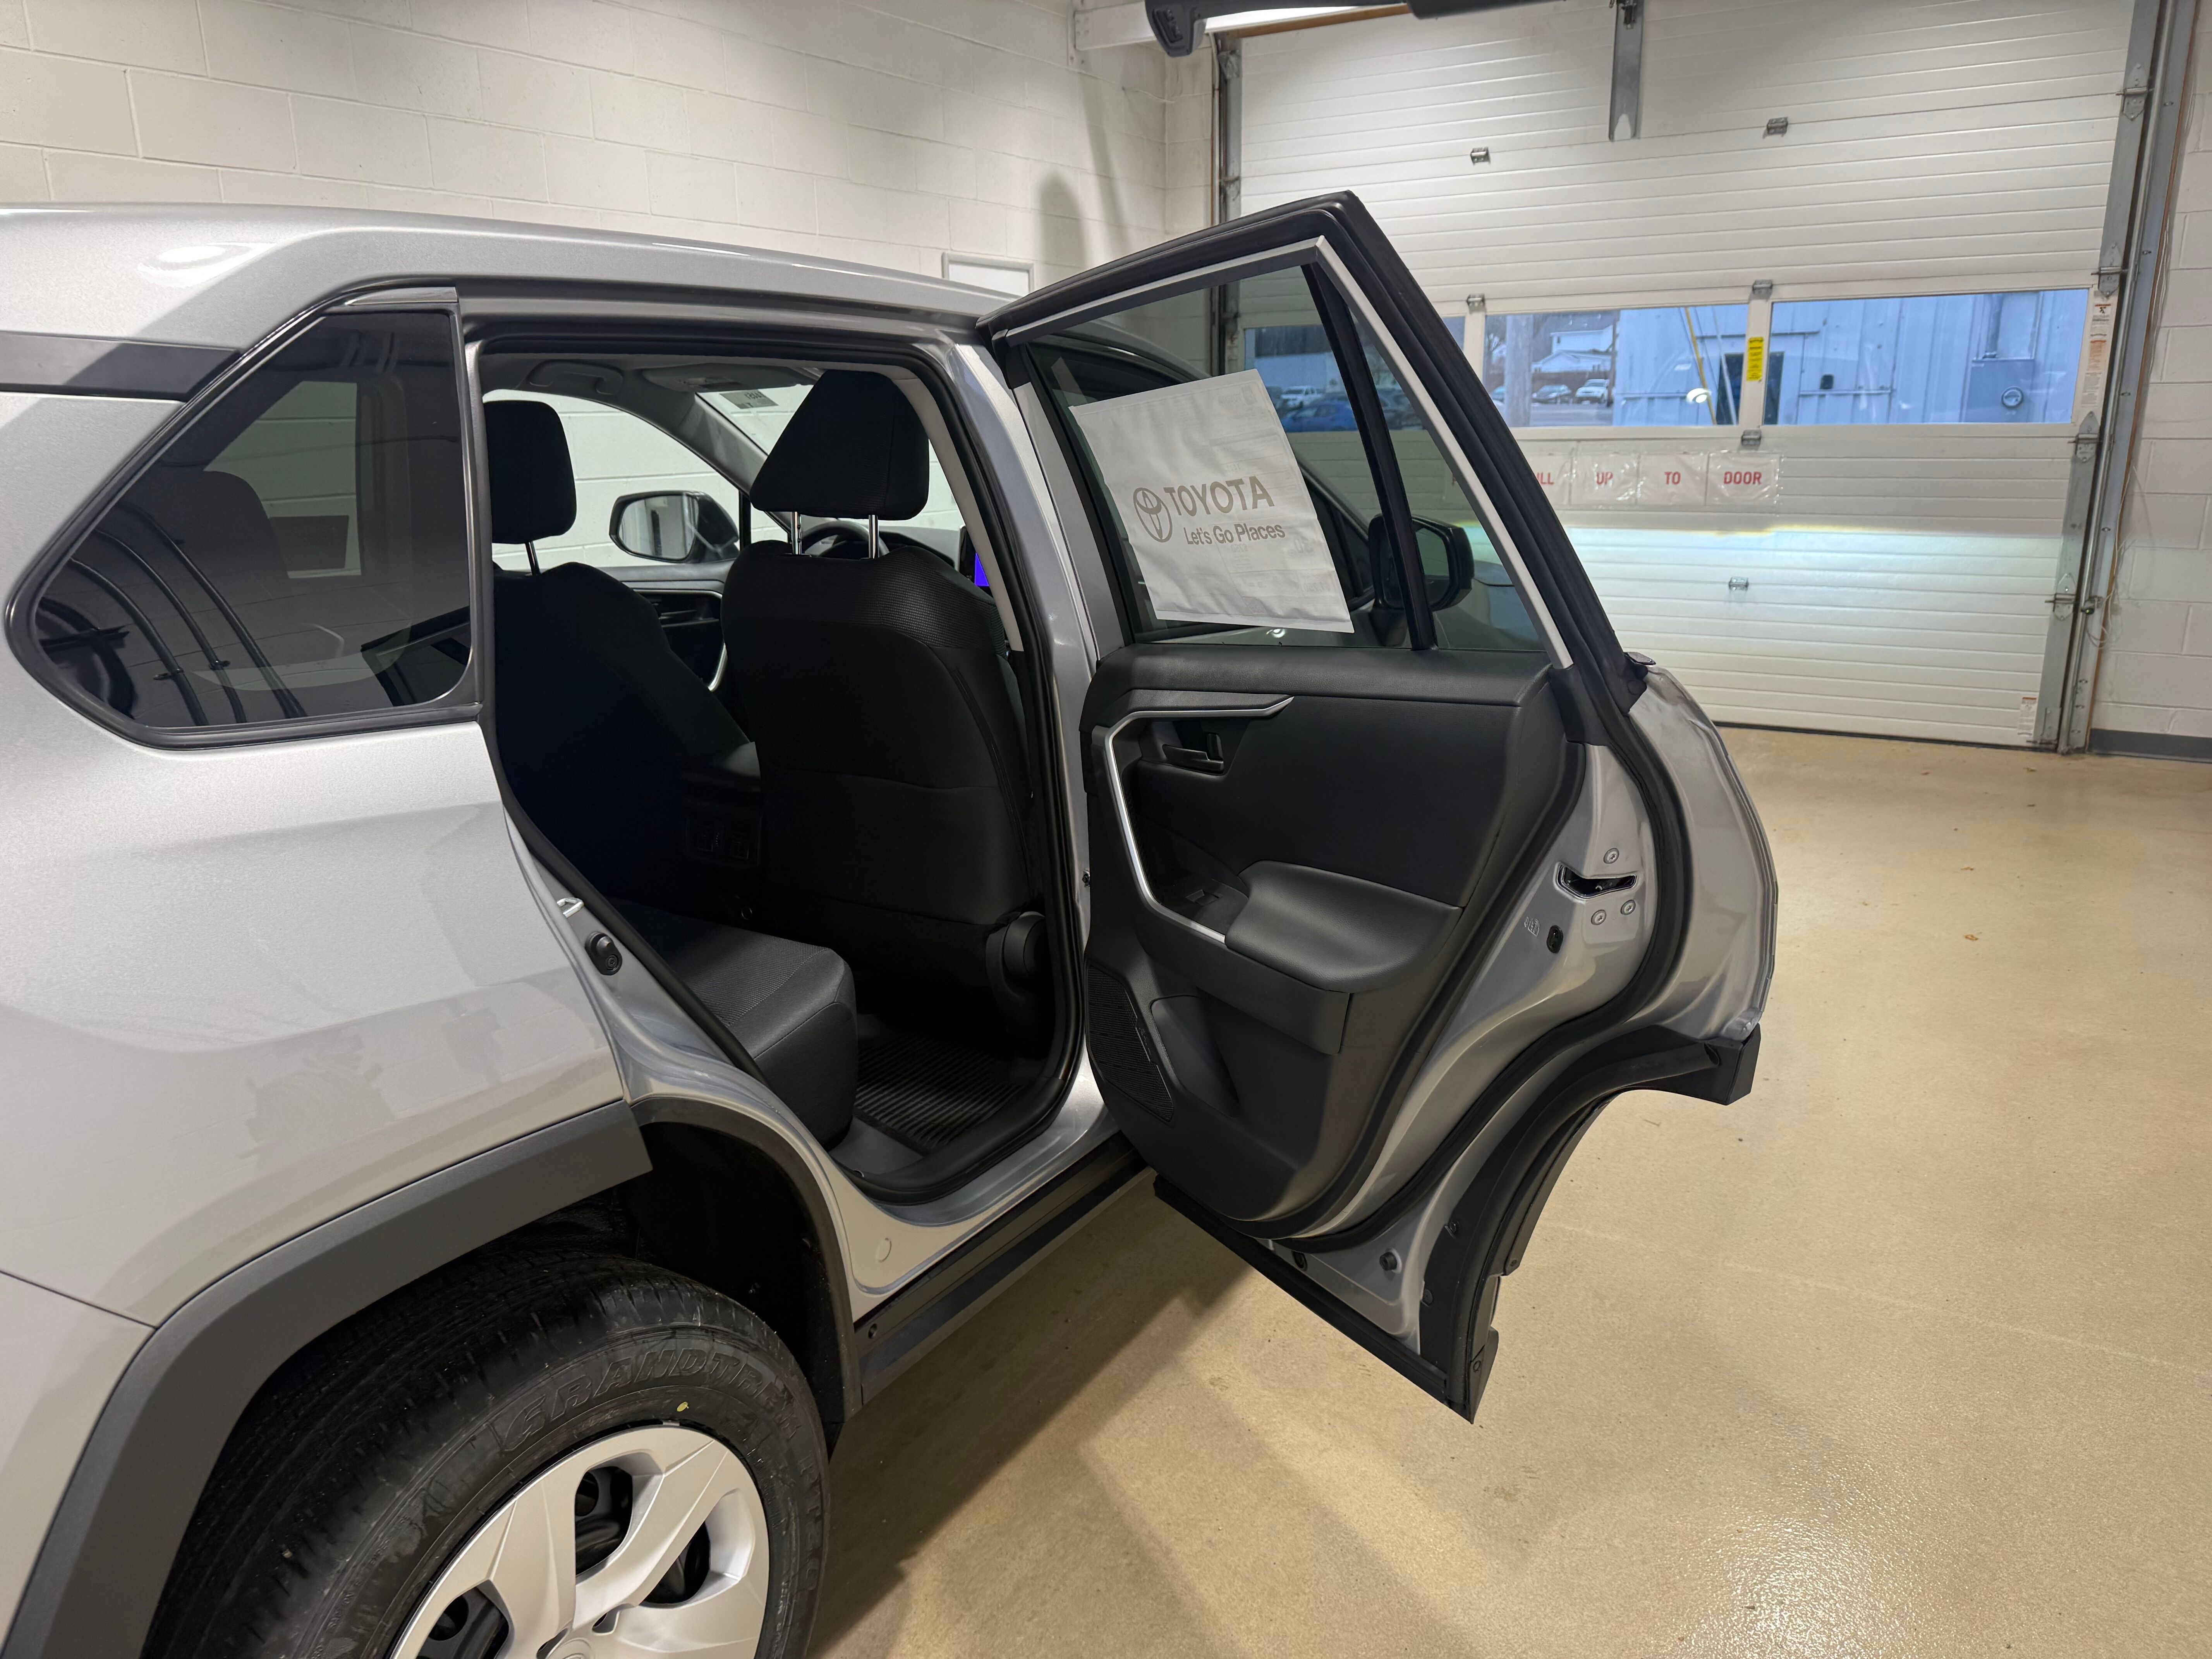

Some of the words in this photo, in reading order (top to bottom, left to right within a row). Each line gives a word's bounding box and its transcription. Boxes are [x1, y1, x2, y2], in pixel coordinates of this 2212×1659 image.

[1536, 472, 1554, 485] LL
[1596, 472, 1614, 485] UP
[1664, 471, 1681, 485] TO
[1723, 471, 1762, 485] DOOR
[1163, 476, 1275, 517] TOYOTA
[1183, 527, 1212, 544] Let's
[1213, 525, 1234, 544] Go
[1234, 523, 1285, 542] Places
